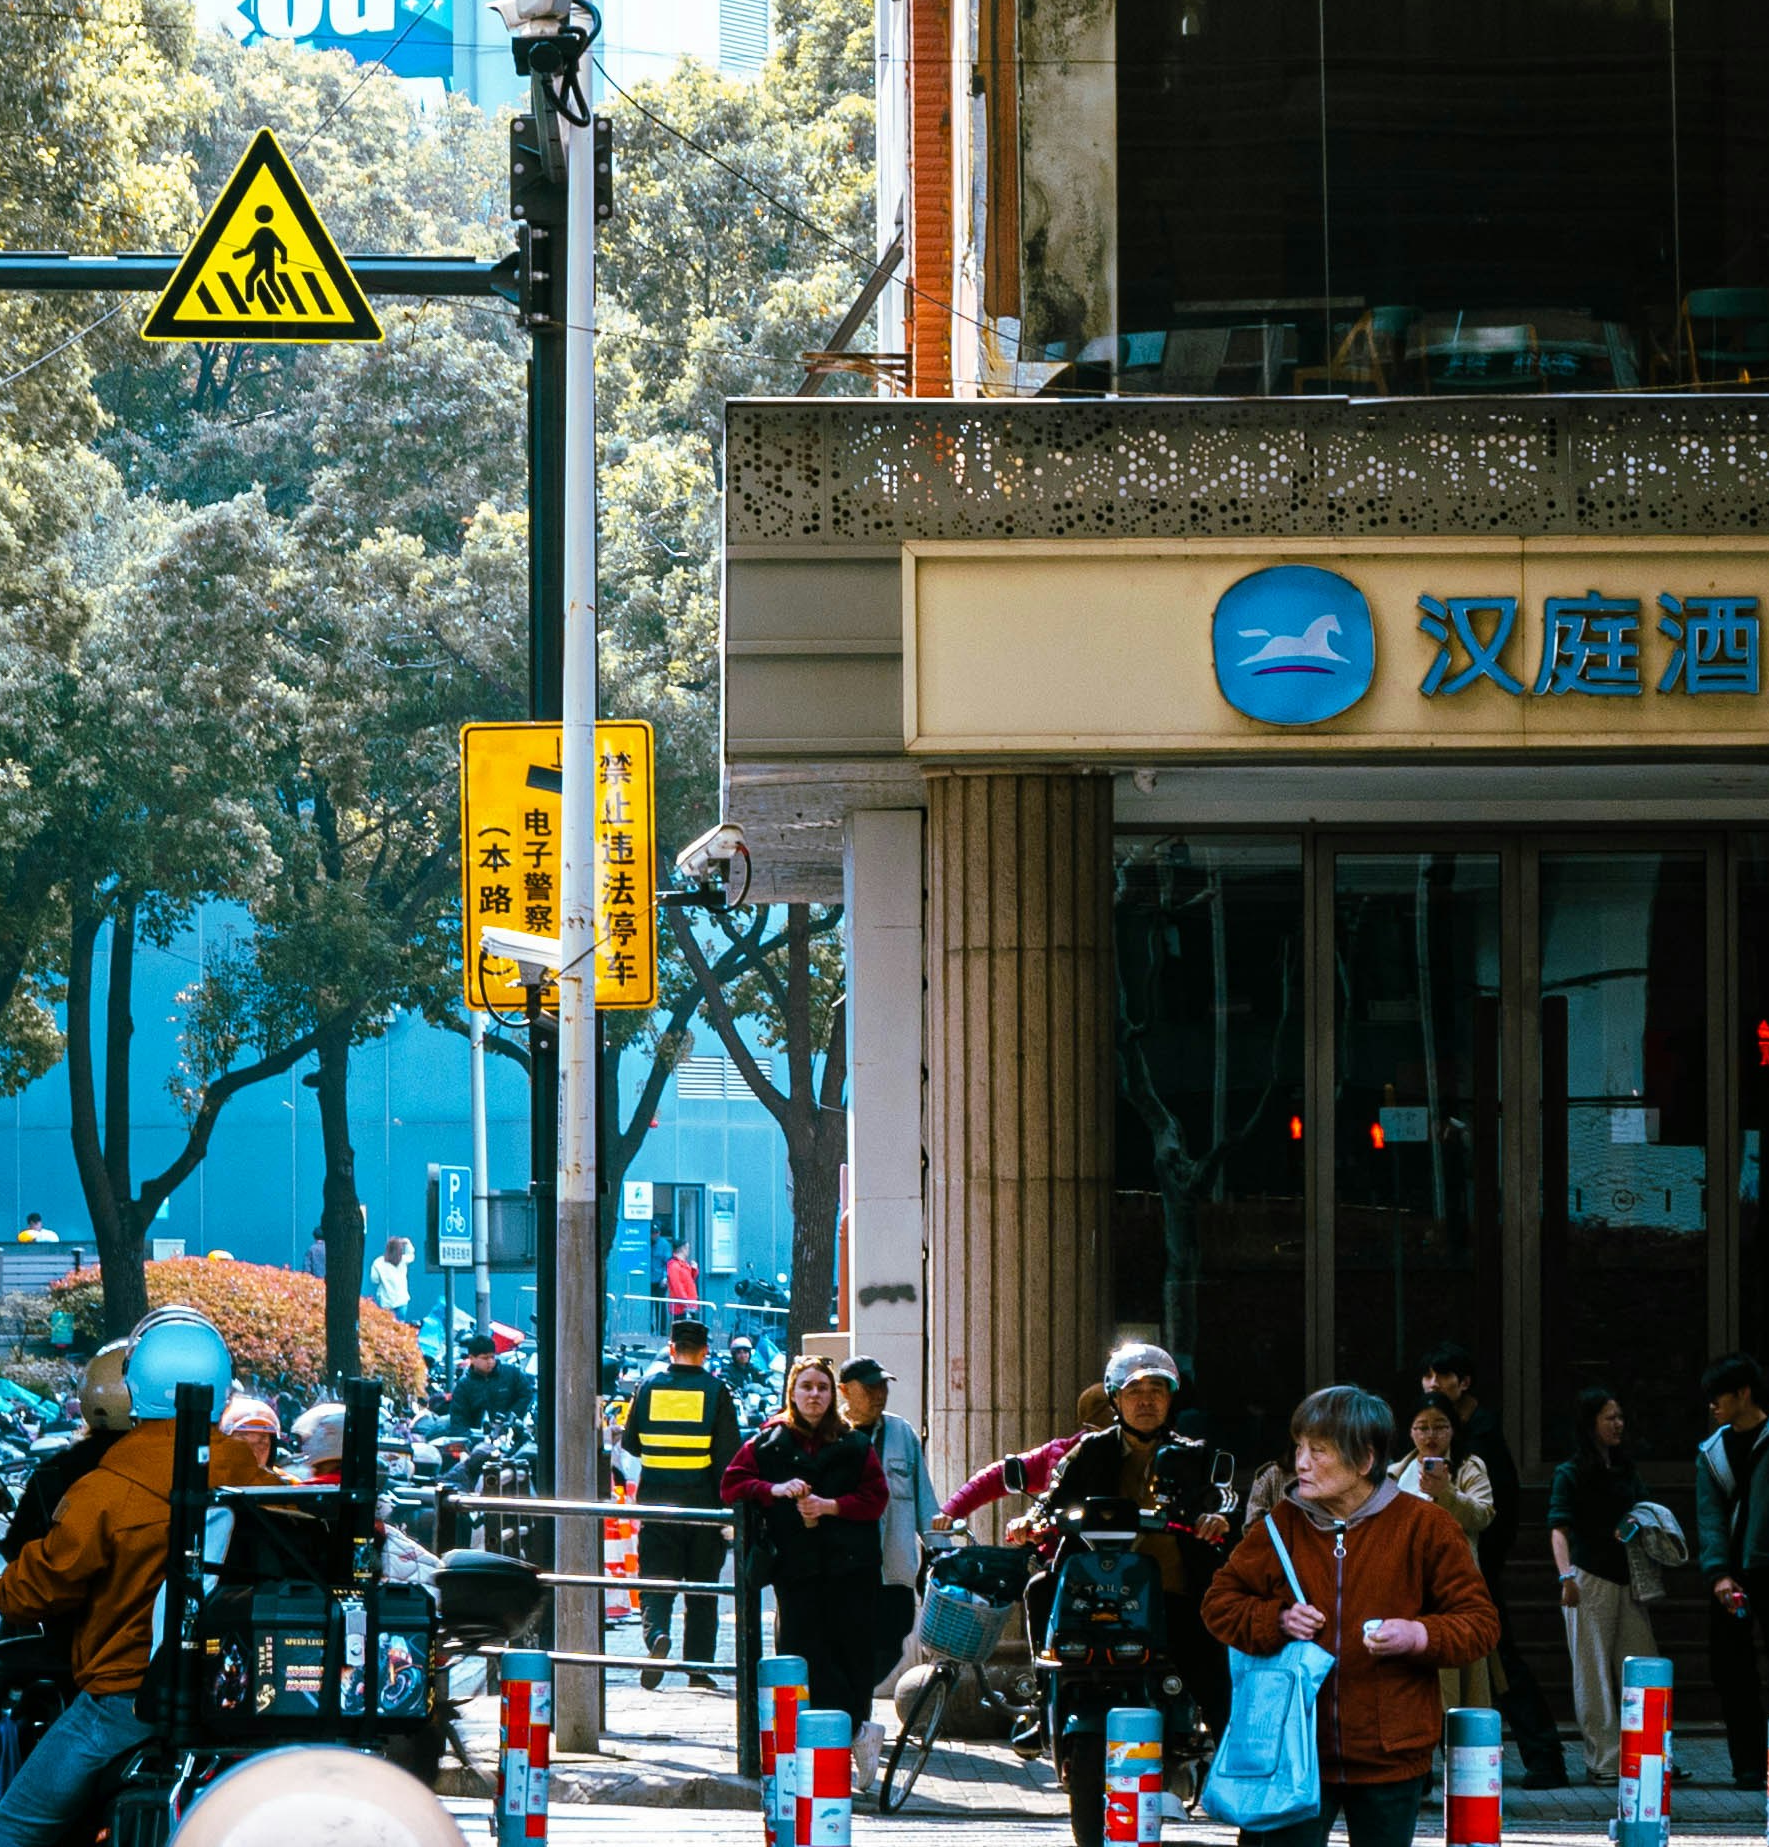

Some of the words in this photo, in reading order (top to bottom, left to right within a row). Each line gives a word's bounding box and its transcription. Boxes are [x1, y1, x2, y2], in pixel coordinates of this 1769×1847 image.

[598, 751, 638, 987] 禁止违法停车
[449, 1173, 461, 1202] P
